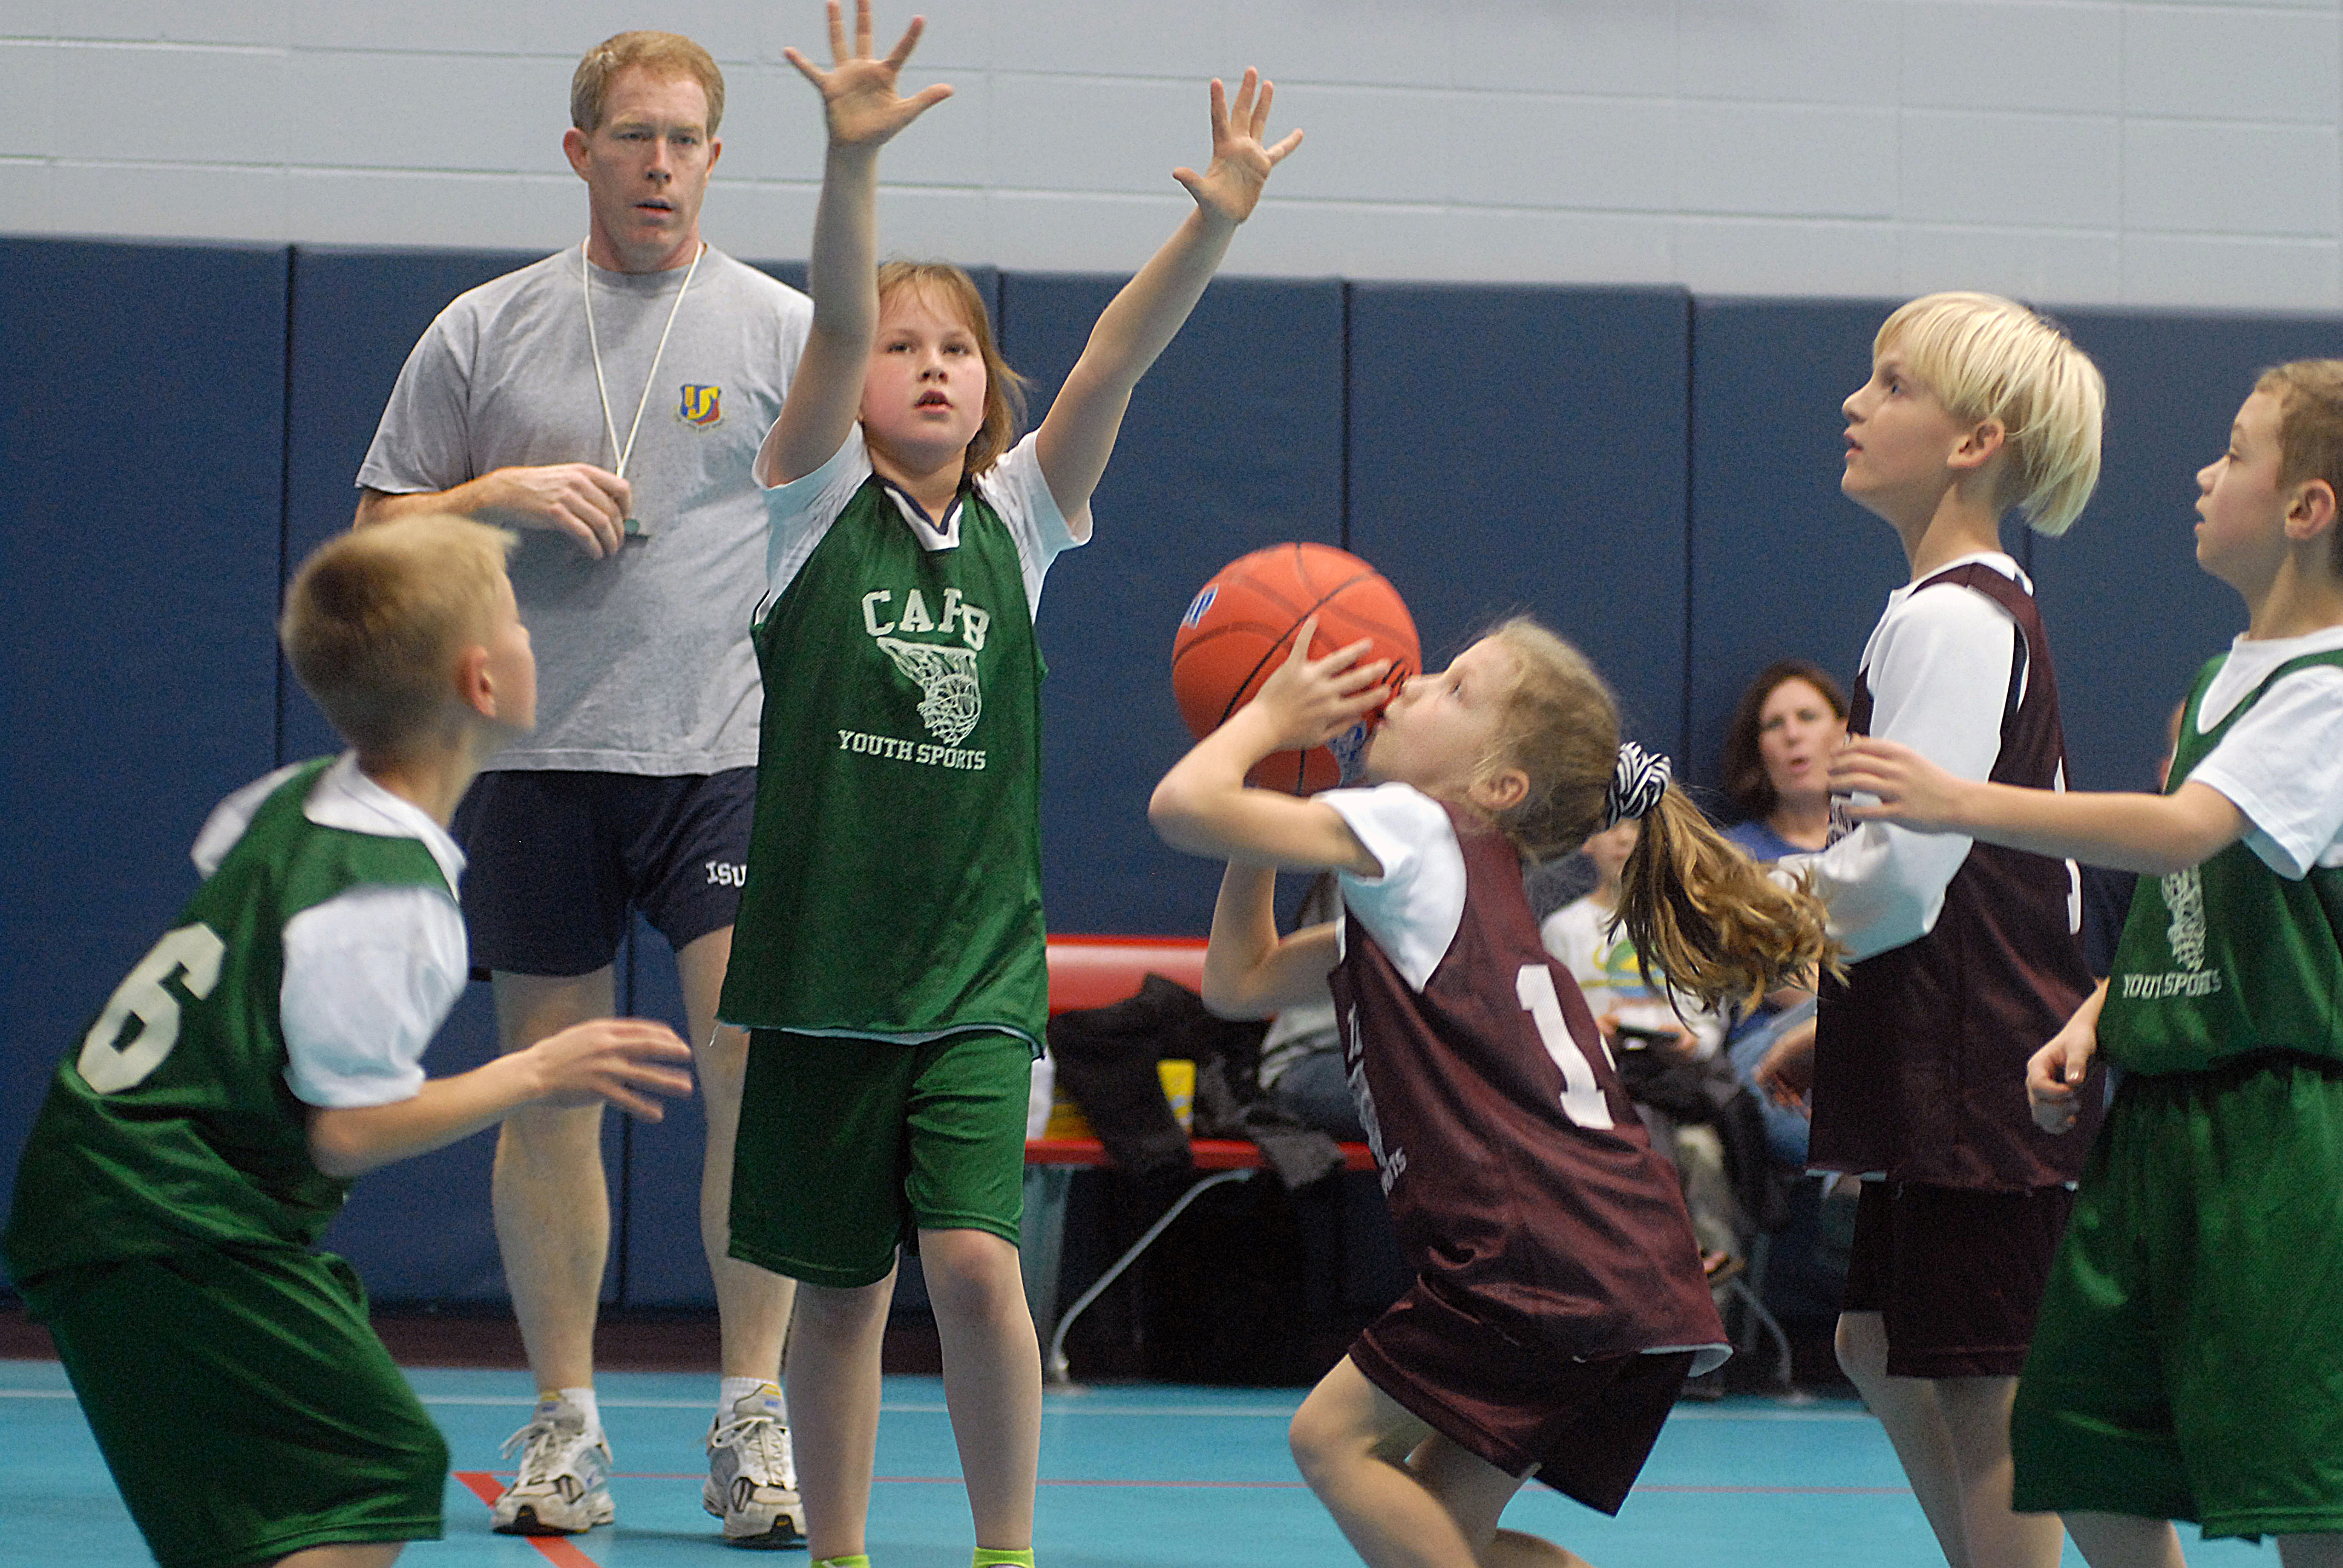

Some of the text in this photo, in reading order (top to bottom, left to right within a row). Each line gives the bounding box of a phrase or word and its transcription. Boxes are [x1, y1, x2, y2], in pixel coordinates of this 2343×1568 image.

[862, 587, 991, 651] CAFB
[838, 730, 986, 771] YOUTH SPORTS
[706, 860, 747, 887] ISU
[77, 921, 226, 1094] 6
[1515, 964, 1616, 1130] 1
